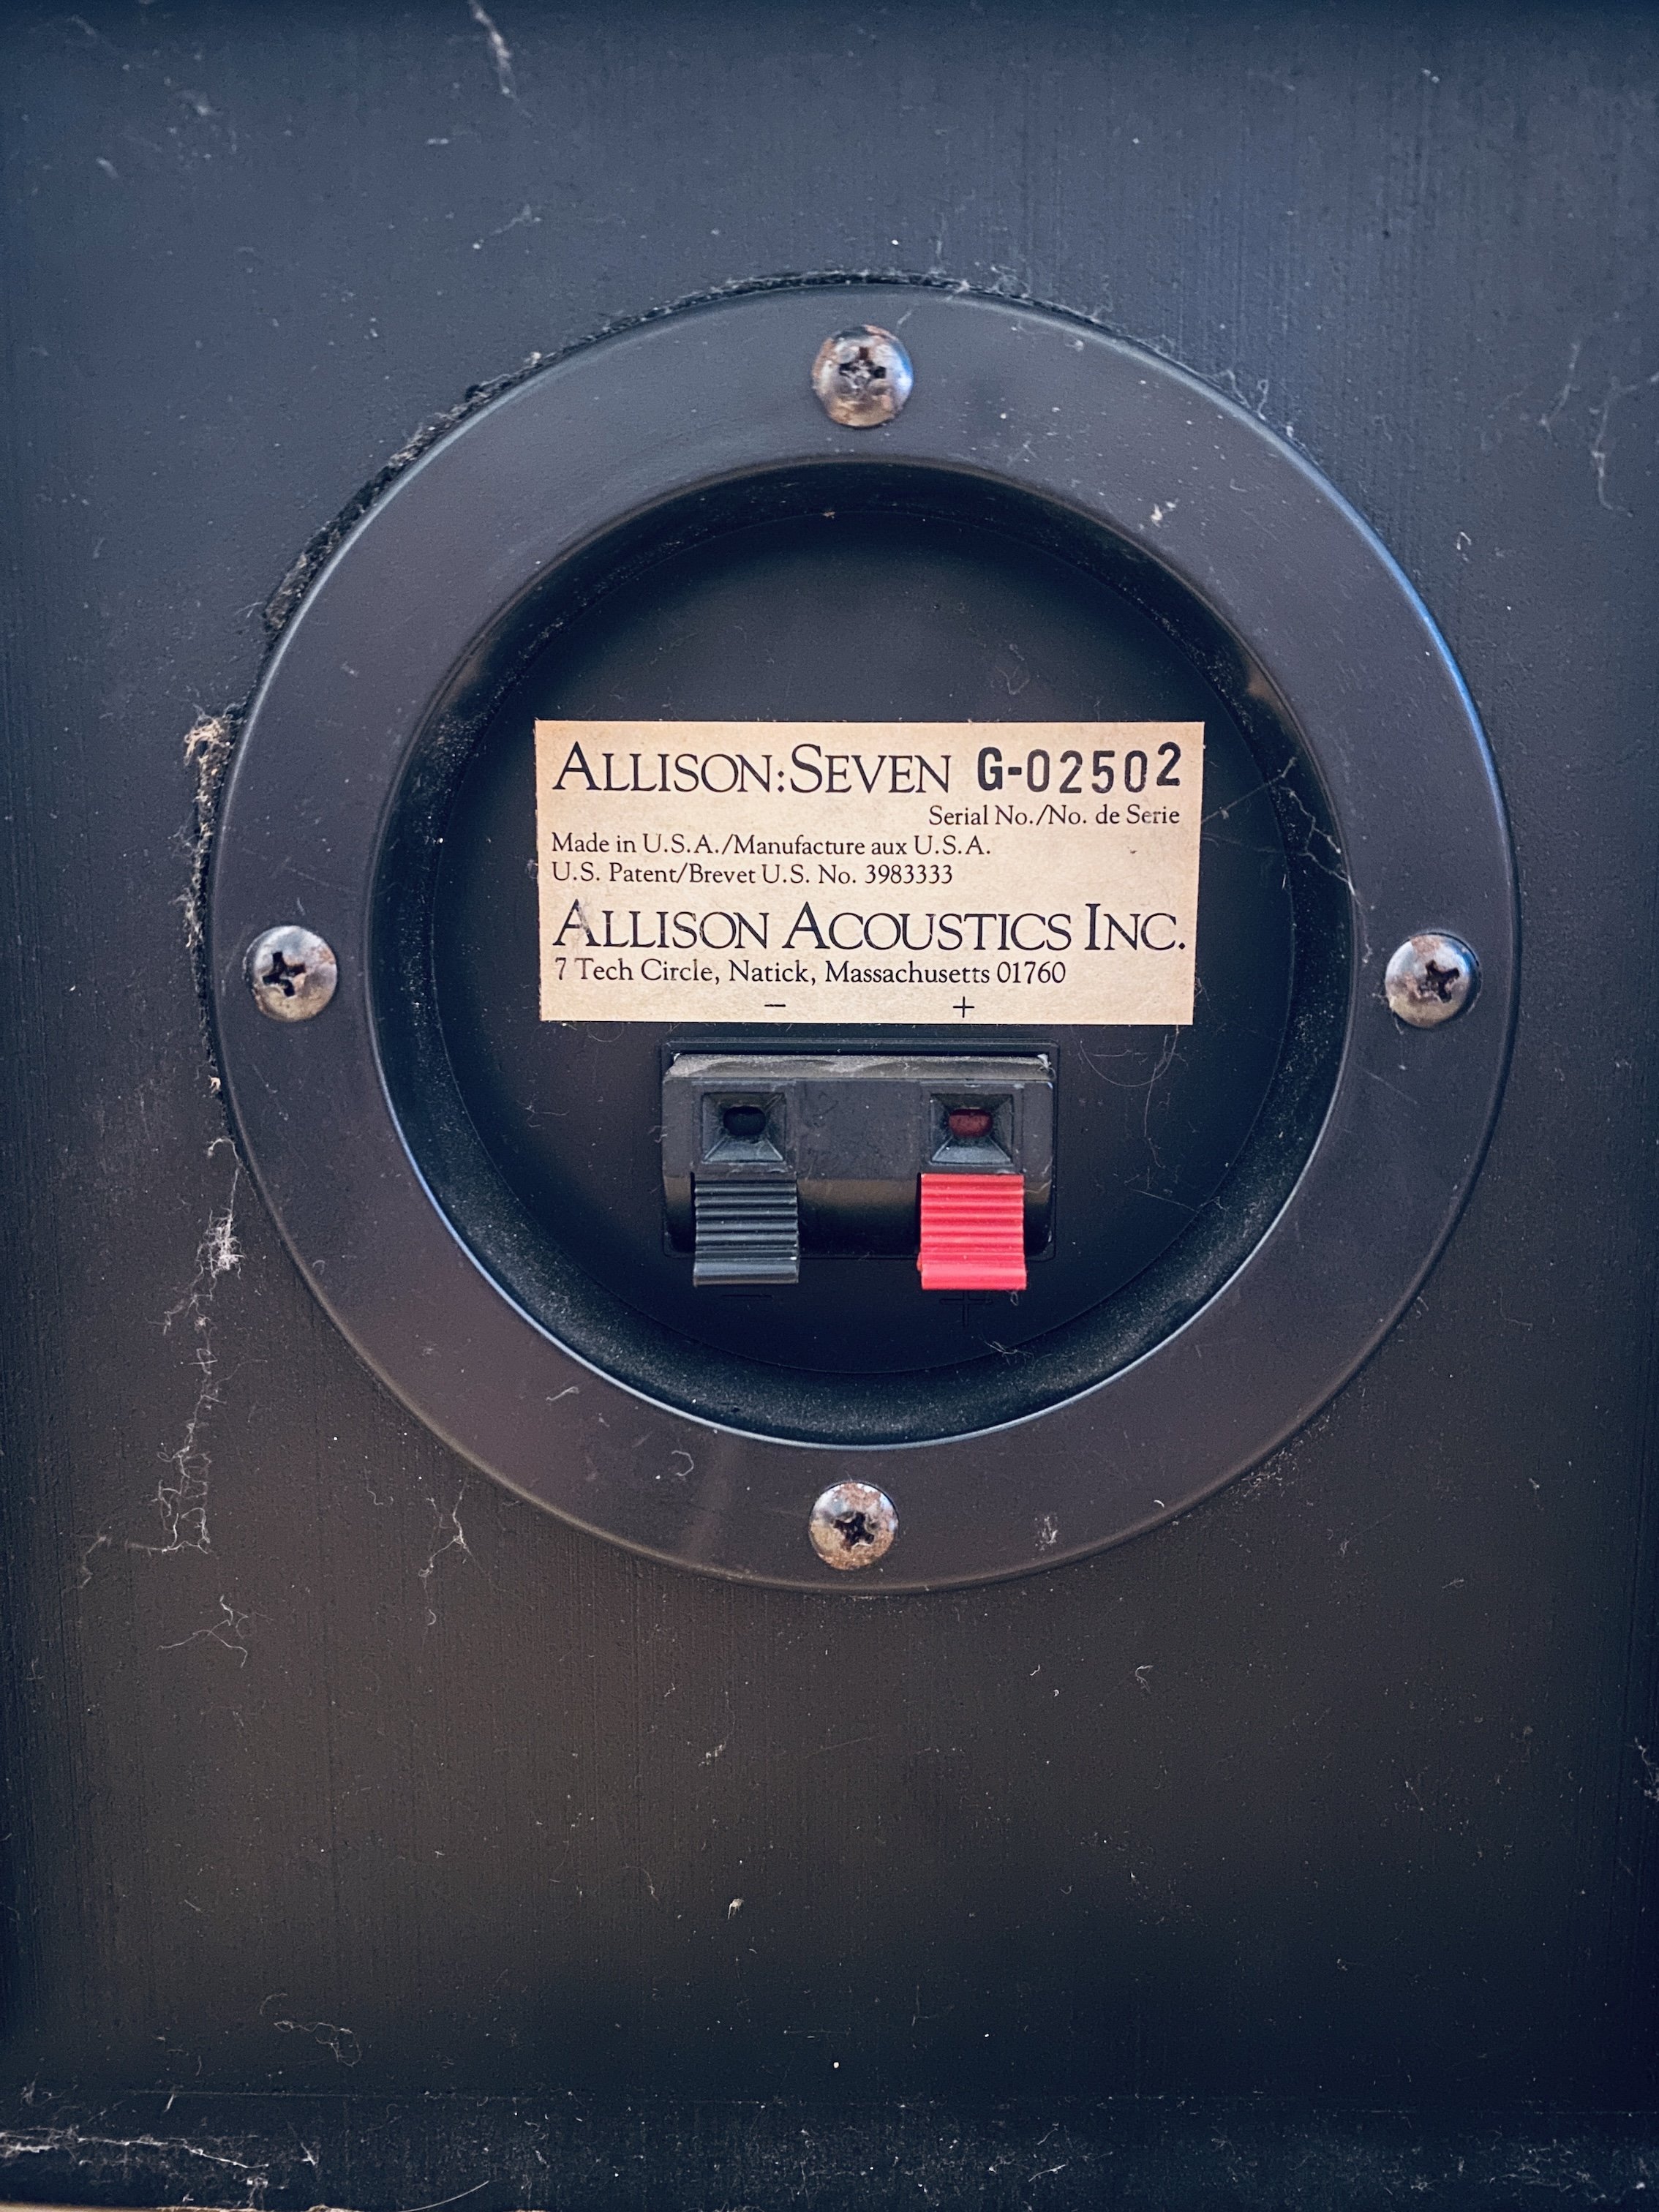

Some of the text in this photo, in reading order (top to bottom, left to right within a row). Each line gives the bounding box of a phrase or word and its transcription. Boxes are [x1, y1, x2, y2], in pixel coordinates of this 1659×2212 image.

[551, 740, 952, 794] ALLISON:SEVEN
[977, 741, 1182, 794] G-02502
[928, 803, 1180, 826] Serial No./No. de Serie
[551, 831, 991, 855] Made in U.S.A./Manufacture aux U.S.A.
[551, 861, 953, 884] U.S. Patent/Brevet U.S. No. 3983333
[552, 898, 1186, 952] ALLISON ACOUSTICS INC.
[554, 957, 1066, 987] 7 Tech Circle, Natick, Massachusetts 01760
